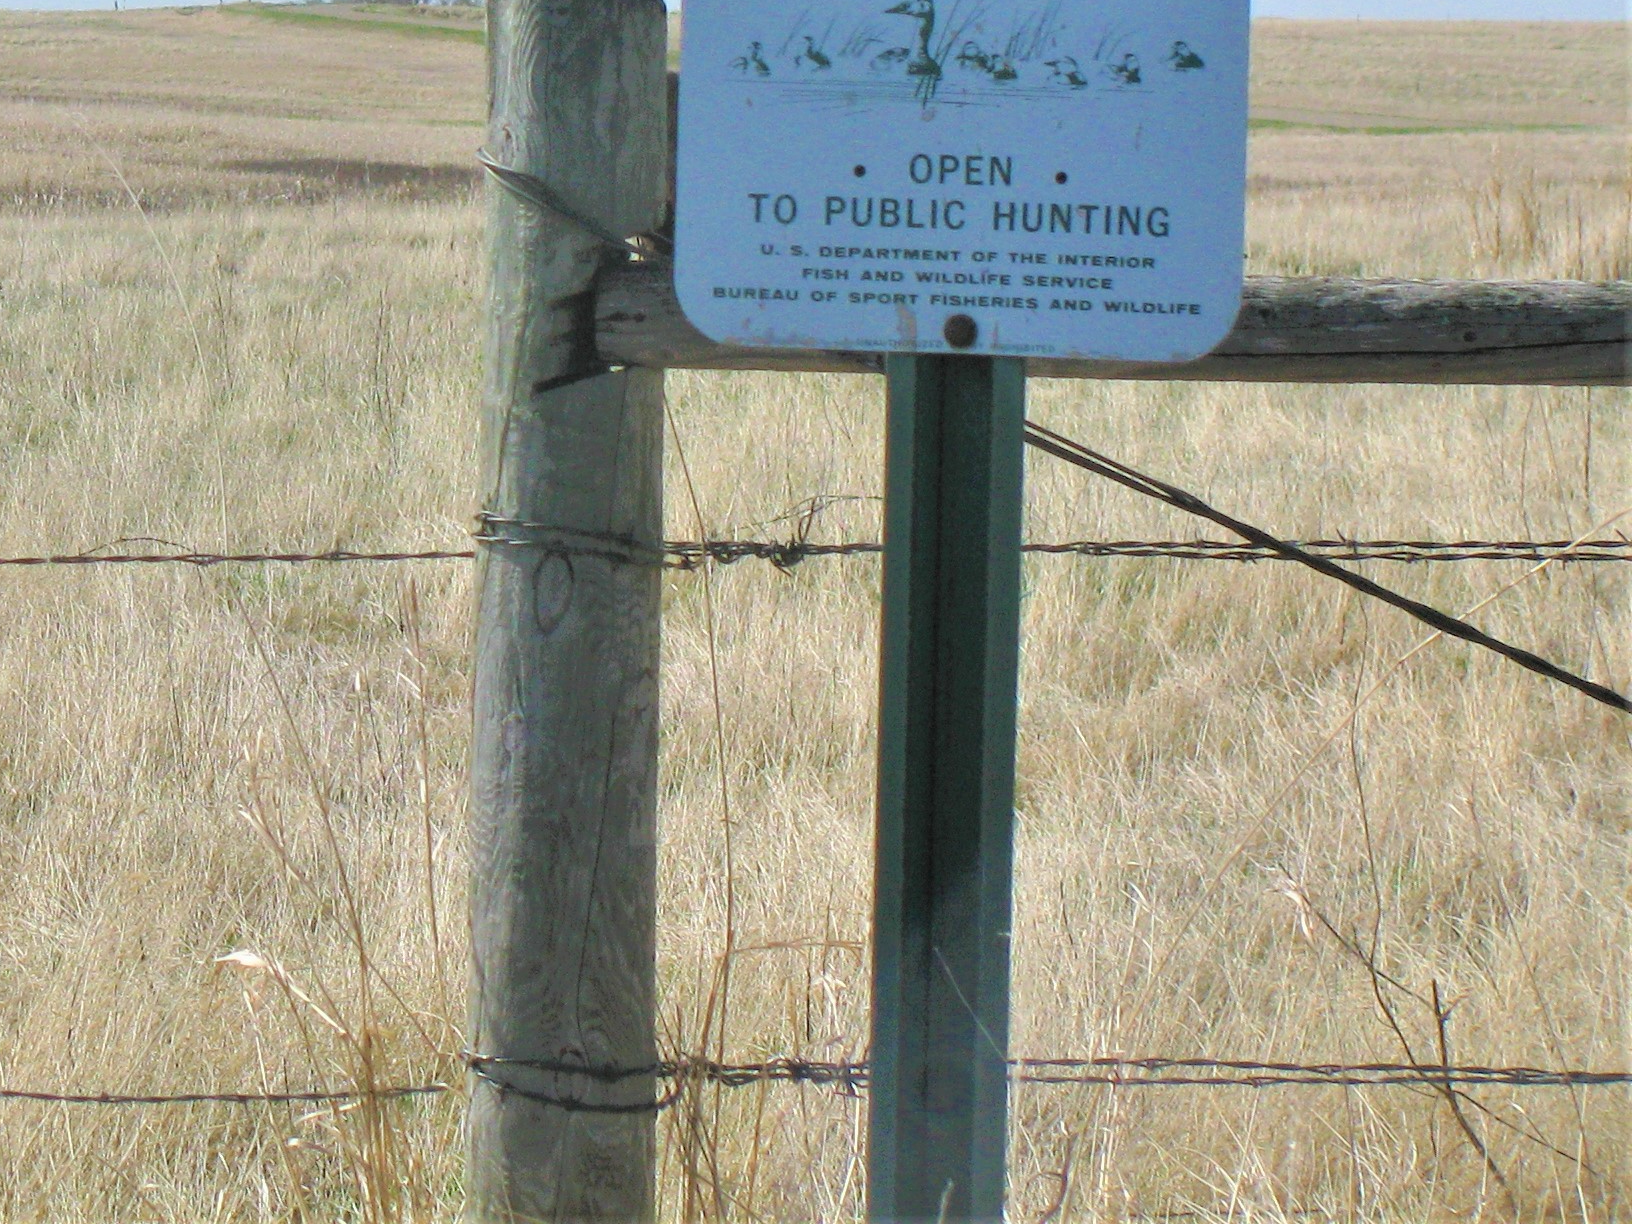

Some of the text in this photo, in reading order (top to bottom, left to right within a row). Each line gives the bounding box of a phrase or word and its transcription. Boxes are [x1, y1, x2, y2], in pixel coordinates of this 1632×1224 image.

[909, 153, 1013, 186] OPEN
[748, 192, 1170, 238] TO PUBLIC HUNTING
[761, 244, 1156, 269] U. S. DEPARTMENT OF THE INTERIOR
[802, 267, 1114, 290] FISH AND WILDLIFE SERVICE
[712, 287, 1202, 316] BUREAU OF SPORT FISHERIES AND WILDLIFE
